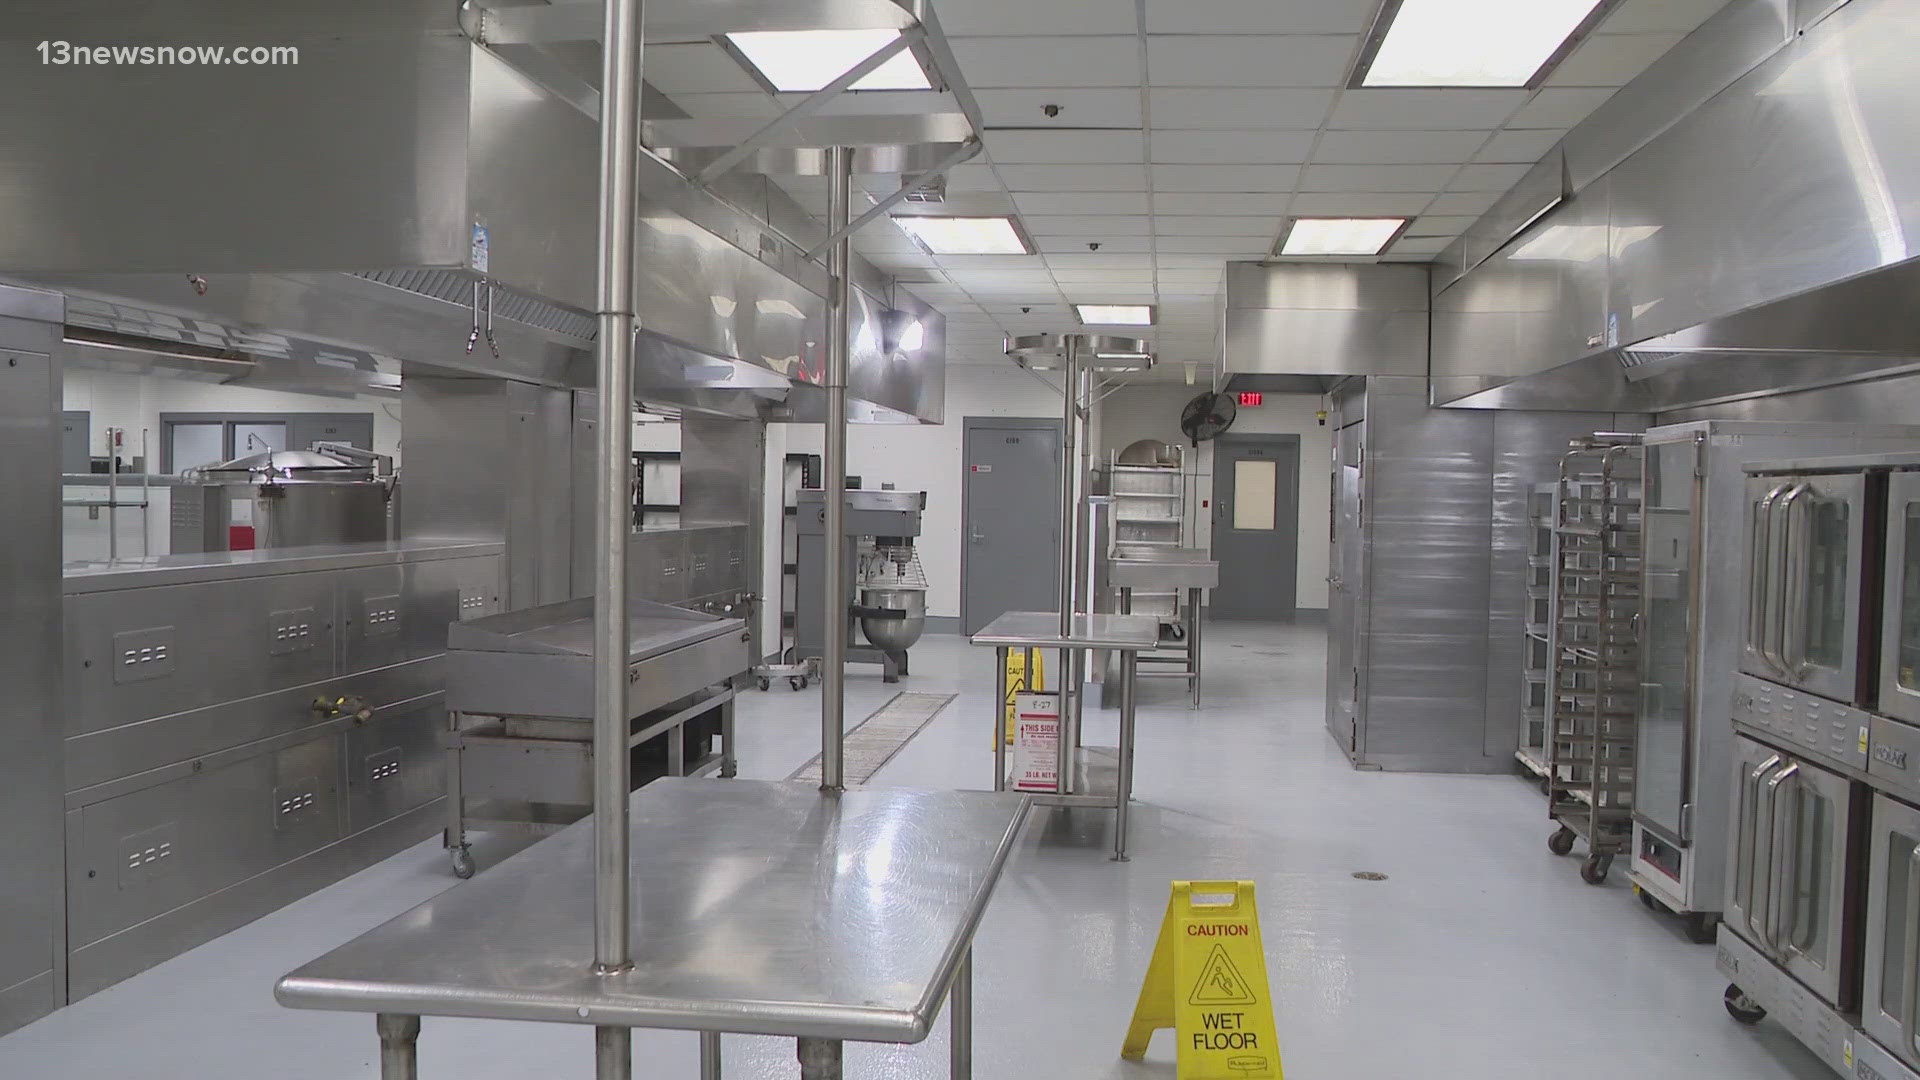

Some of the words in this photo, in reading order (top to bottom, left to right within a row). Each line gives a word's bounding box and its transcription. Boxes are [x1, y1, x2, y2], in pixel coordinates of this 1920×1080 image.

[1241, 393, 1261, 405] EXIT
[1025, 724, 1039, 732] THIS
[1040, 724, 1055, 732] SIDE
[1187, 924, 1249, 937] CAUTION
[1202, 1012, 1245, 1030] WET
[1193, 1032, 1258, 1050] FLOOR
